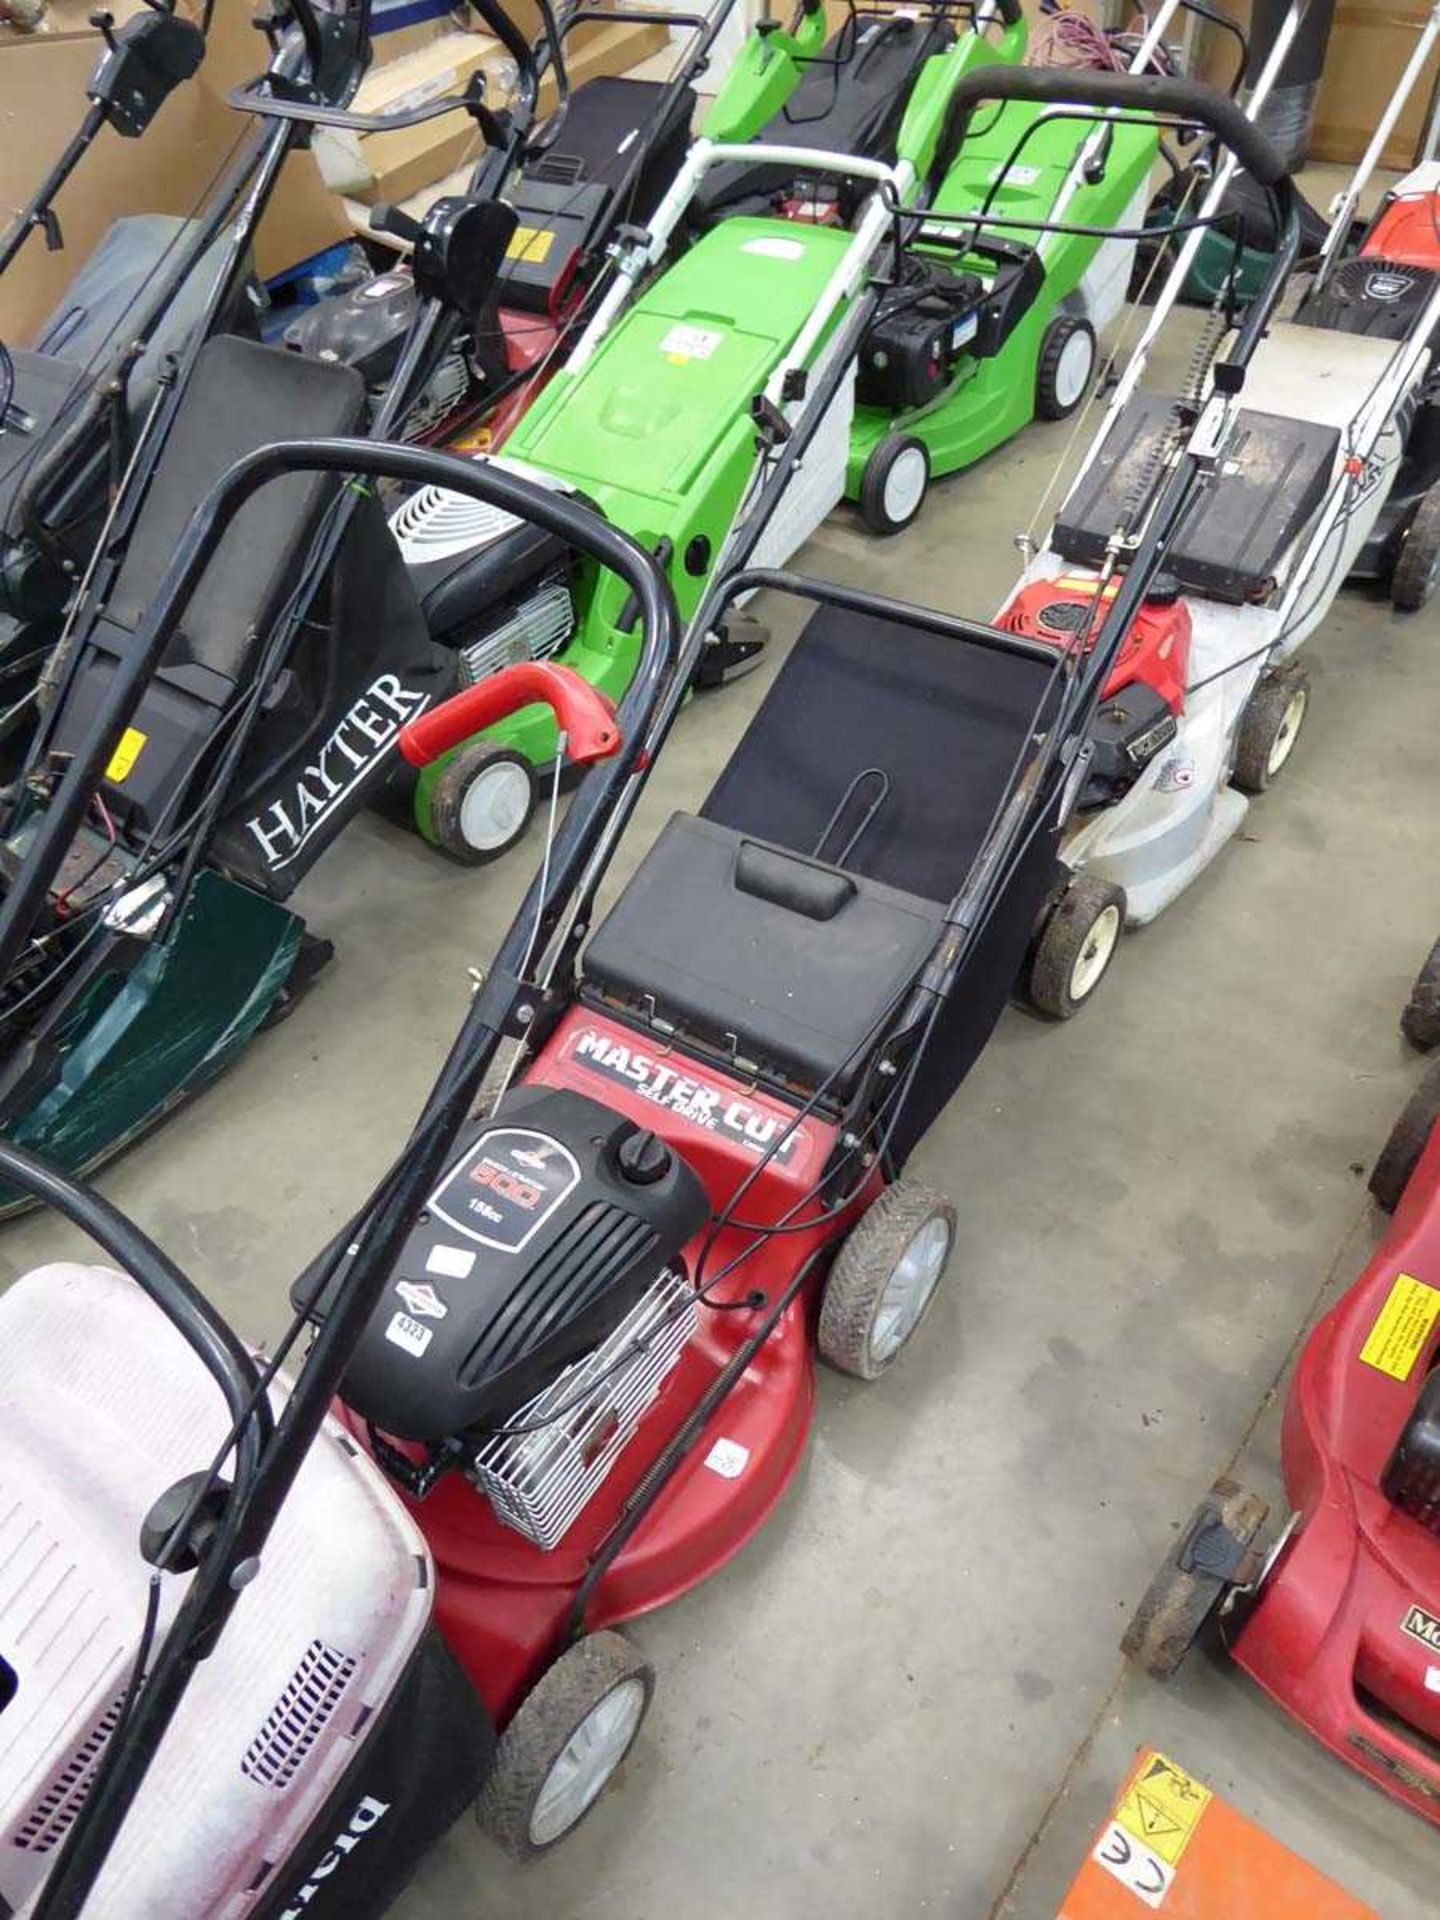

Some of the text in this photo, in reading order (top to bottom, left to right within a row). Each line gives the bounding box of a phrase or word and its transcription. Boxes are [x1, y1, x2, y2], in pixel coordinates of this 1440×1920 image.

[246, 674, 424, 862] HAYTER
[576, 1032, 804, 1153] MASTER CUT
[637, 1083, 719, 1130] SELF DRIVE
[470, 1162, 540, 1210] 500
